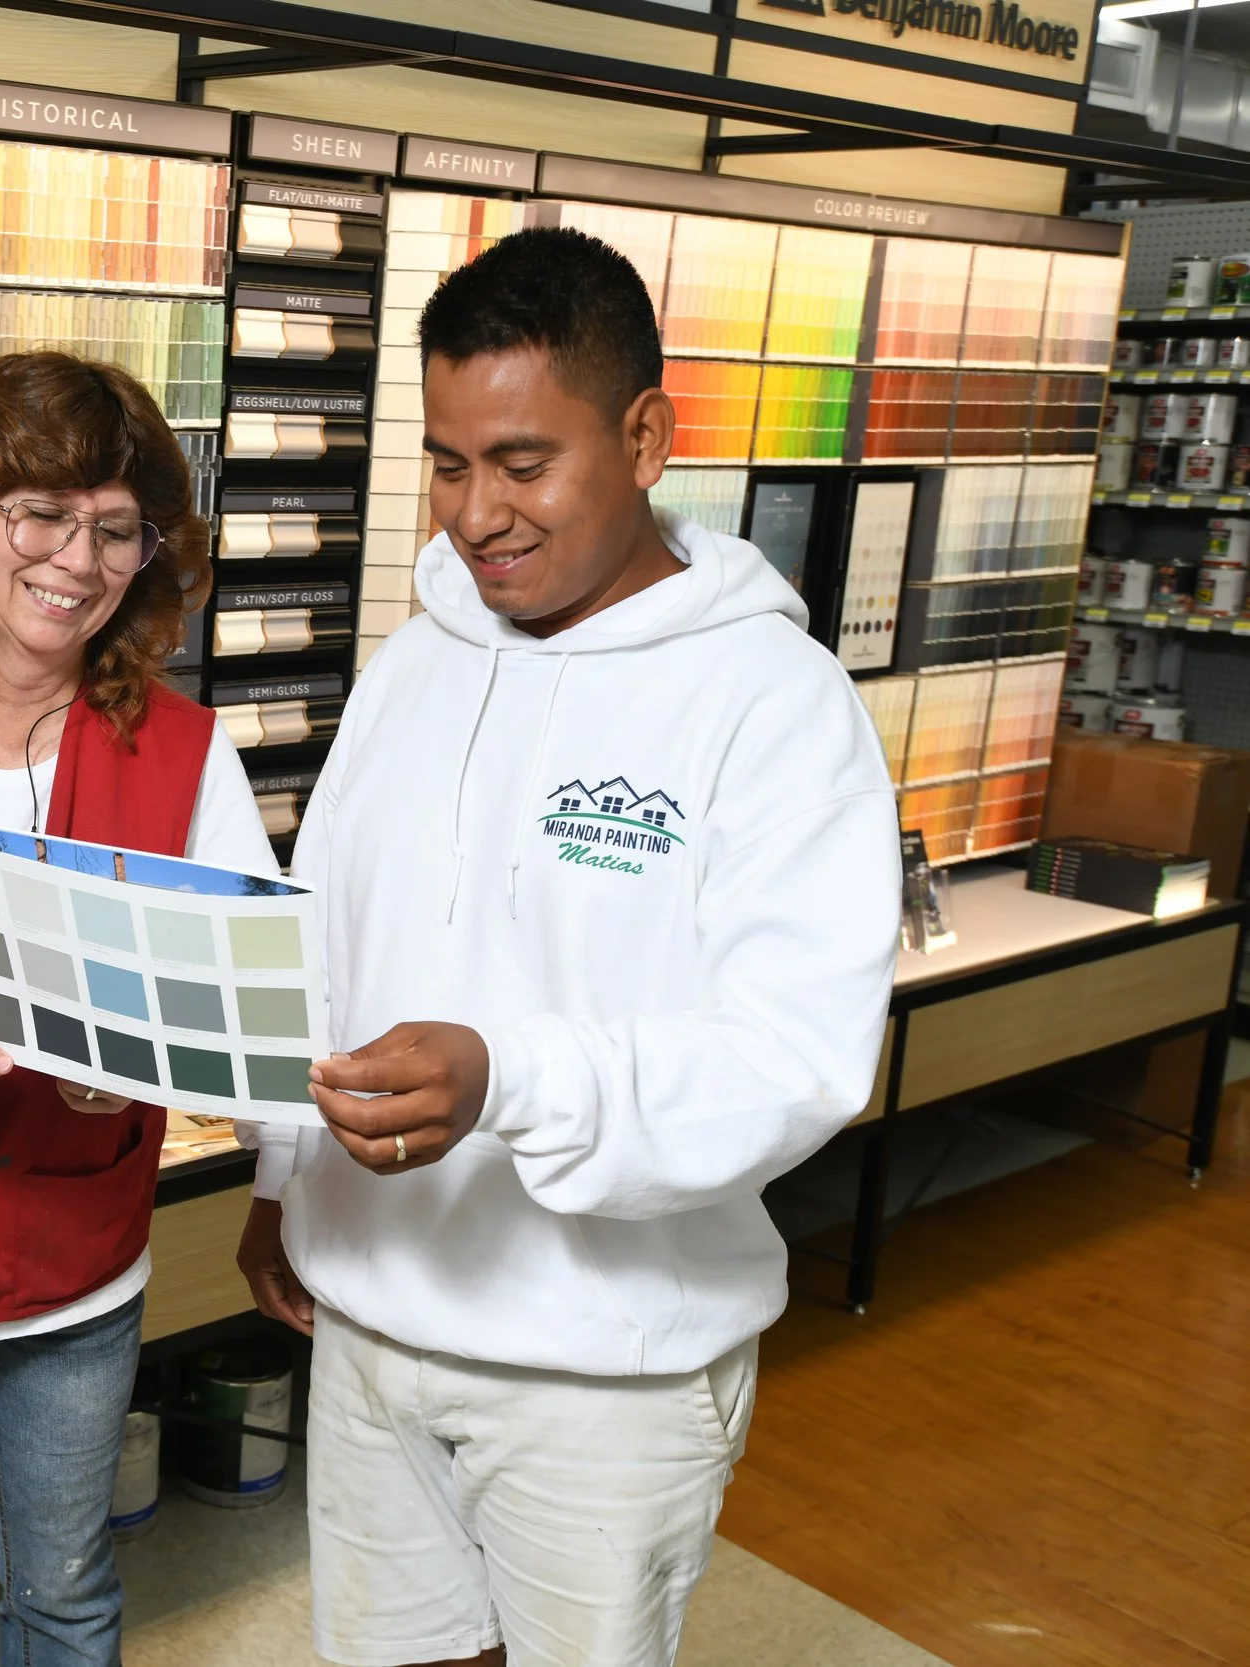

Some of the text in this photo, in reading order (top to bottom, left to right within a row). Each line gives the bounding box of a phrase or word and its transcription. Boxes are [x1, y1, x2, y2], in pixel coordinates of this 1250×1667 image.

[983, 2, 1079, 61] Moore
[291, 133, 362, 159] SHEEN
[424, 151, 516, 178] AFFINITY
[269, 189, 363, 210] FLAT/ULTI-MATTE
[814, 198, 929, 226] COLOR PREVIEW
[286, 295, 322, 309] MATTE
[235, 396, 363, 411] EGGSHELL/LOW LUSTRE
[272, 497, 306, 508] PEARL
[235, 591, 334, 606] SATIN/SOFT GLOSS
[248, 683, 310, 699] SEMI-GLOSS
[268, 776, 301, 790] GLOSS
[542, 818, 672, 855] MIRANDA PAINTING
[558, 841, 645, 875] Matias
